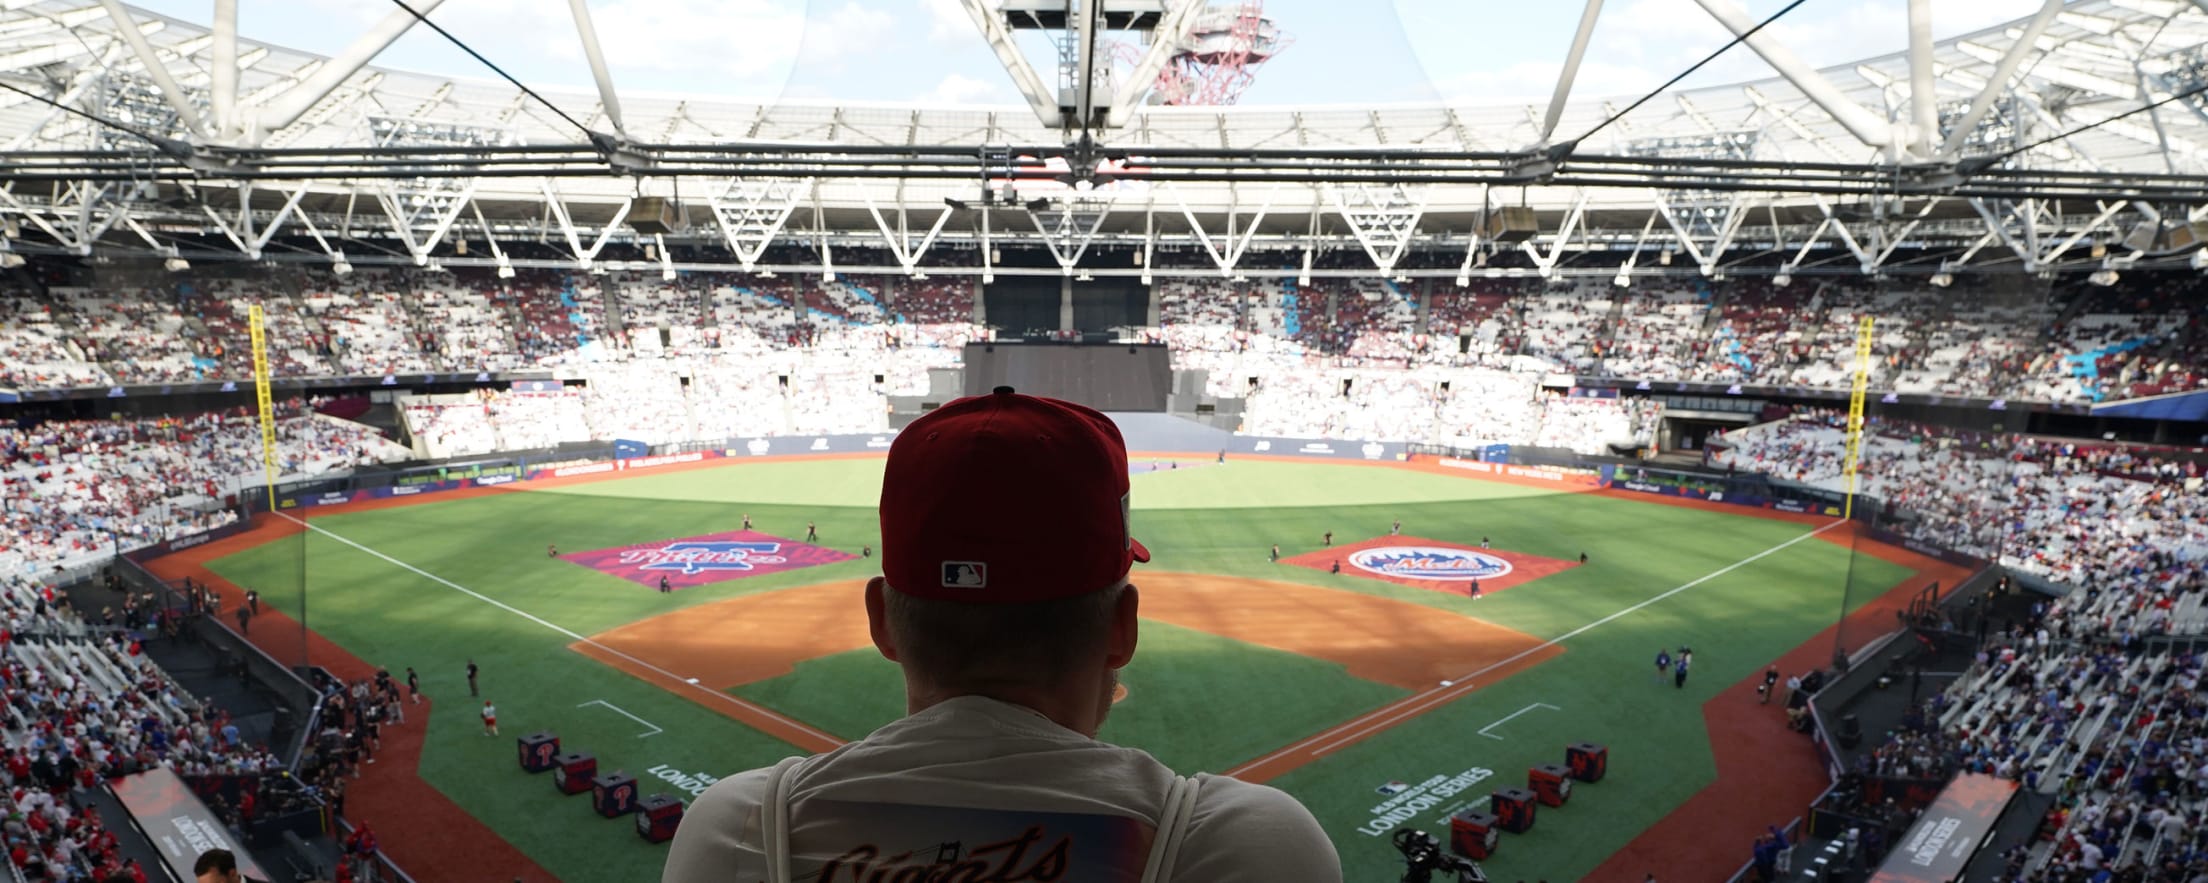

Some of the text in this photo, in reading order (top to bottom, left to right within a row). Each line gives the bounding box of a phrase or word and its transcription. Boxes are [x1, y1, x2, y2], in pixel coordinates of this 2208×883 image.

[647, 764, 706, 796] LONDO
[1357, 793, 1443, 837] LONDON
[1431, 766, 1494, 798] SERIES
